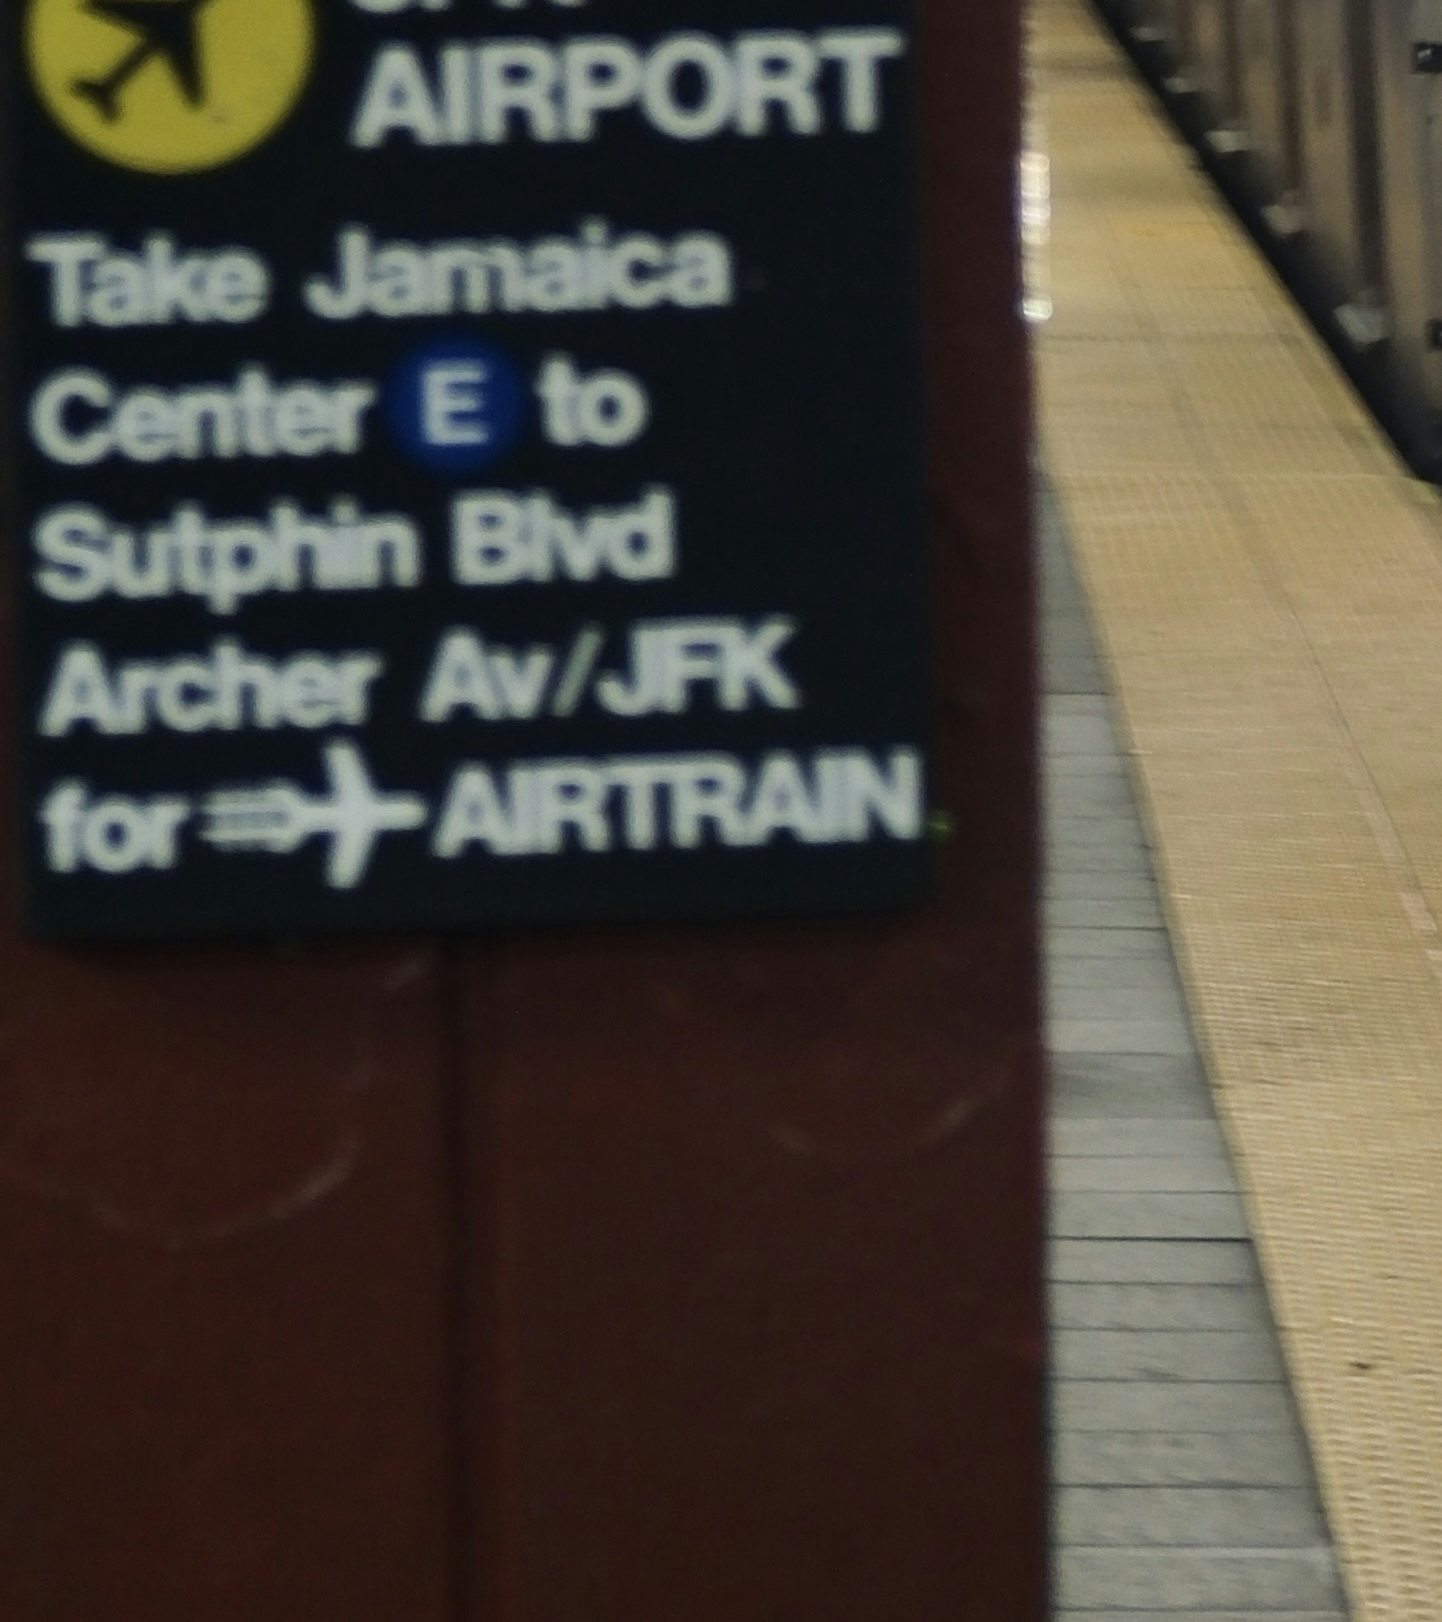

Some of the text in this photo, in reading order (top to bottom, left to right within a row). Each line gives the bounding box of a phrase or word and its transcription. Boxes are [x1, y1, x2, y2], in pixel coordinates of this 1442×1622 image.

[353, 29, 903, 147] AIRPORT
[28, 219, 732, 326] Take Jamaica
[31, 357, 646, 465] Center E to
[35, 490, 674, 614] Sutphin Blvd
[42, 640, 381, 736] Archer
[41, 750, 920, 872] for AIRTRAIN
